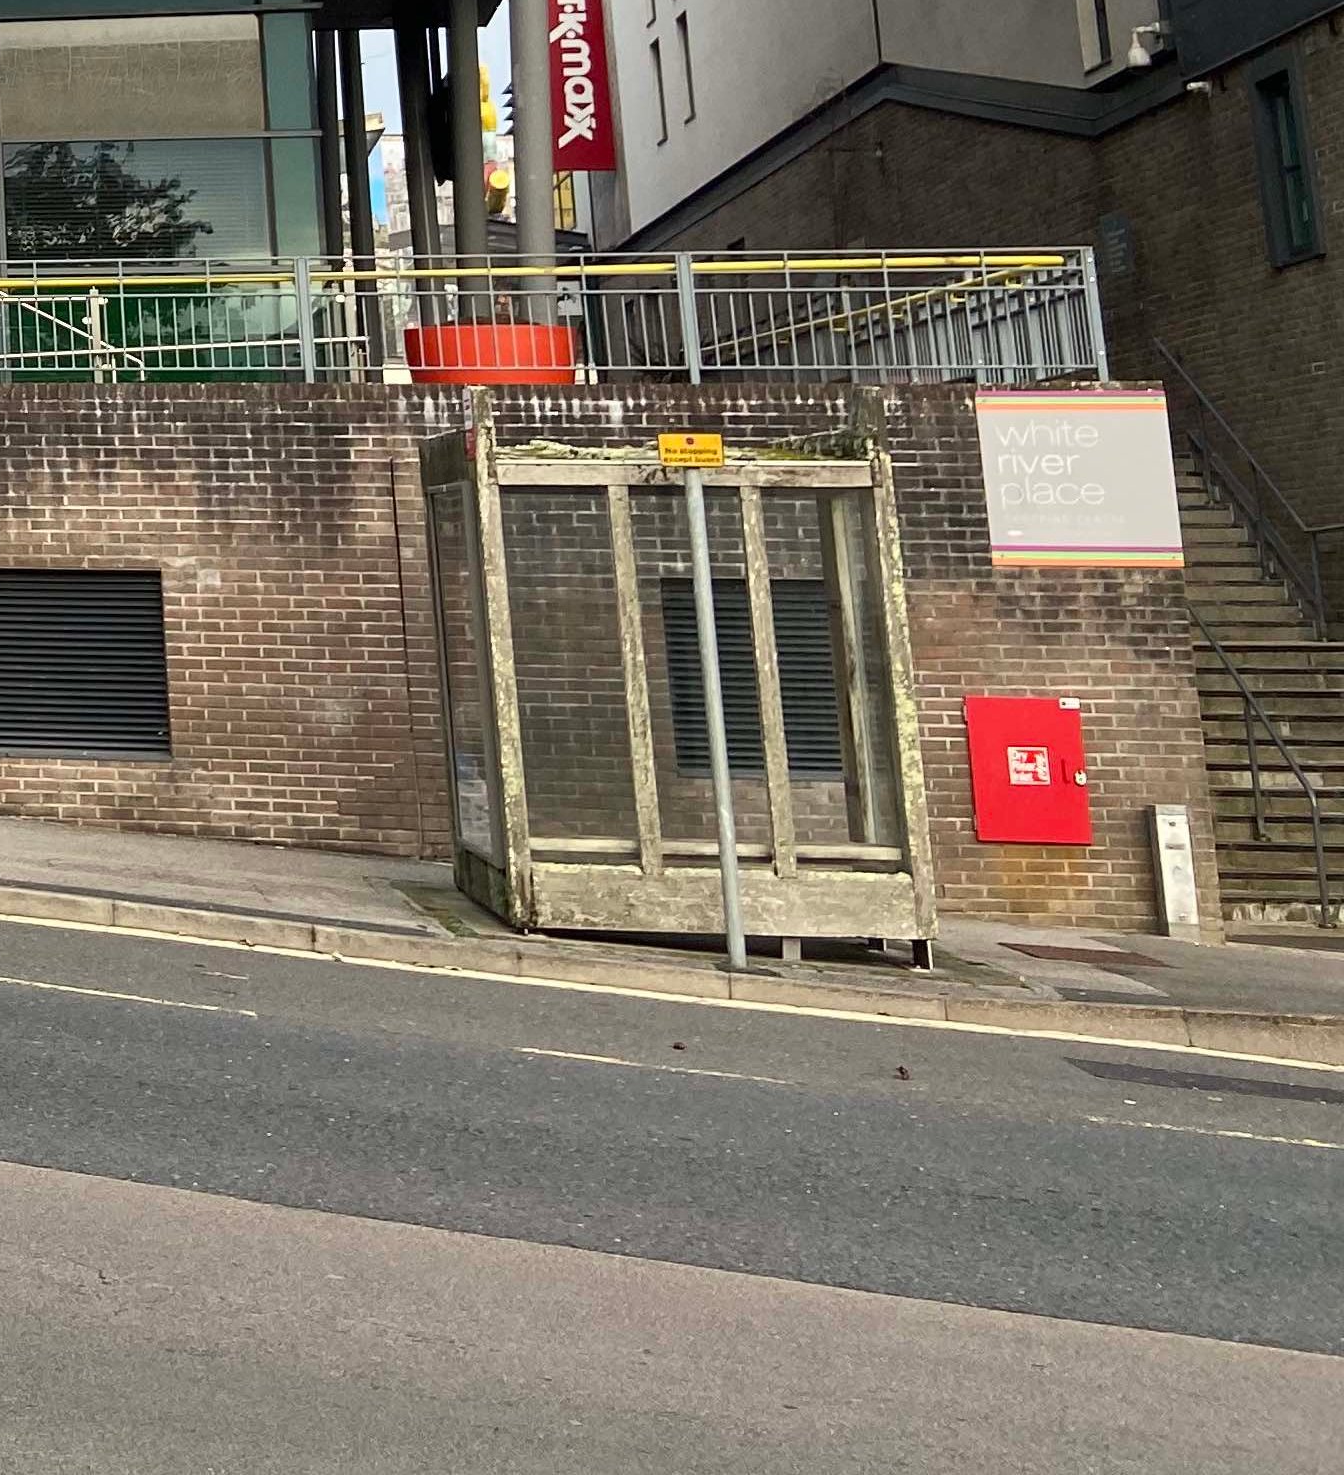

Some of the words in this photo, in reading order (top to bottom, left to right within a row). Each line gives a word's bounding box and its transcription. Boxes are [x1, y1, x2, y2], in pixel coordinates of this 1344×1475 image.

[993, 419, 1100, 448] white
[997, 448, 1081, 475] river
[1000, 475, 1105, 509] place
